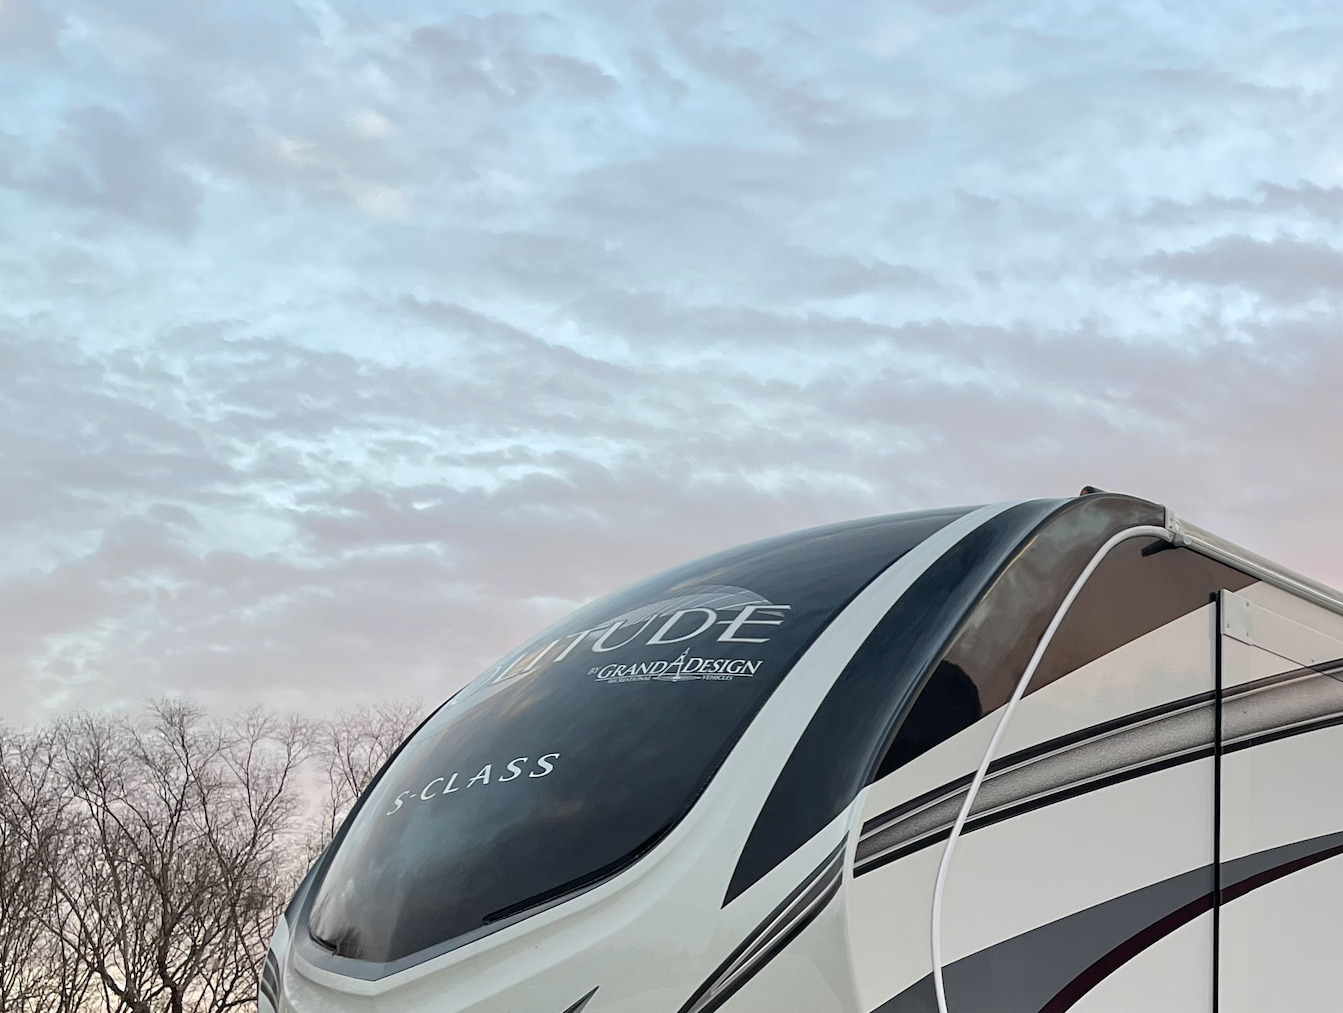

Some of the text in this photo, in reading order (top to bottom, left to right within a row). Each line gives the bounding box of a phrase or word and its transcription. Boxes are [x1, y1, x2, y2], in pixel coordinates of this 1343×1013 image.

[598, 663, 667, 679] GRAND
[682, 658, 762, 674] DESIGN
[386, 753, 561, 816] S-CLASS
